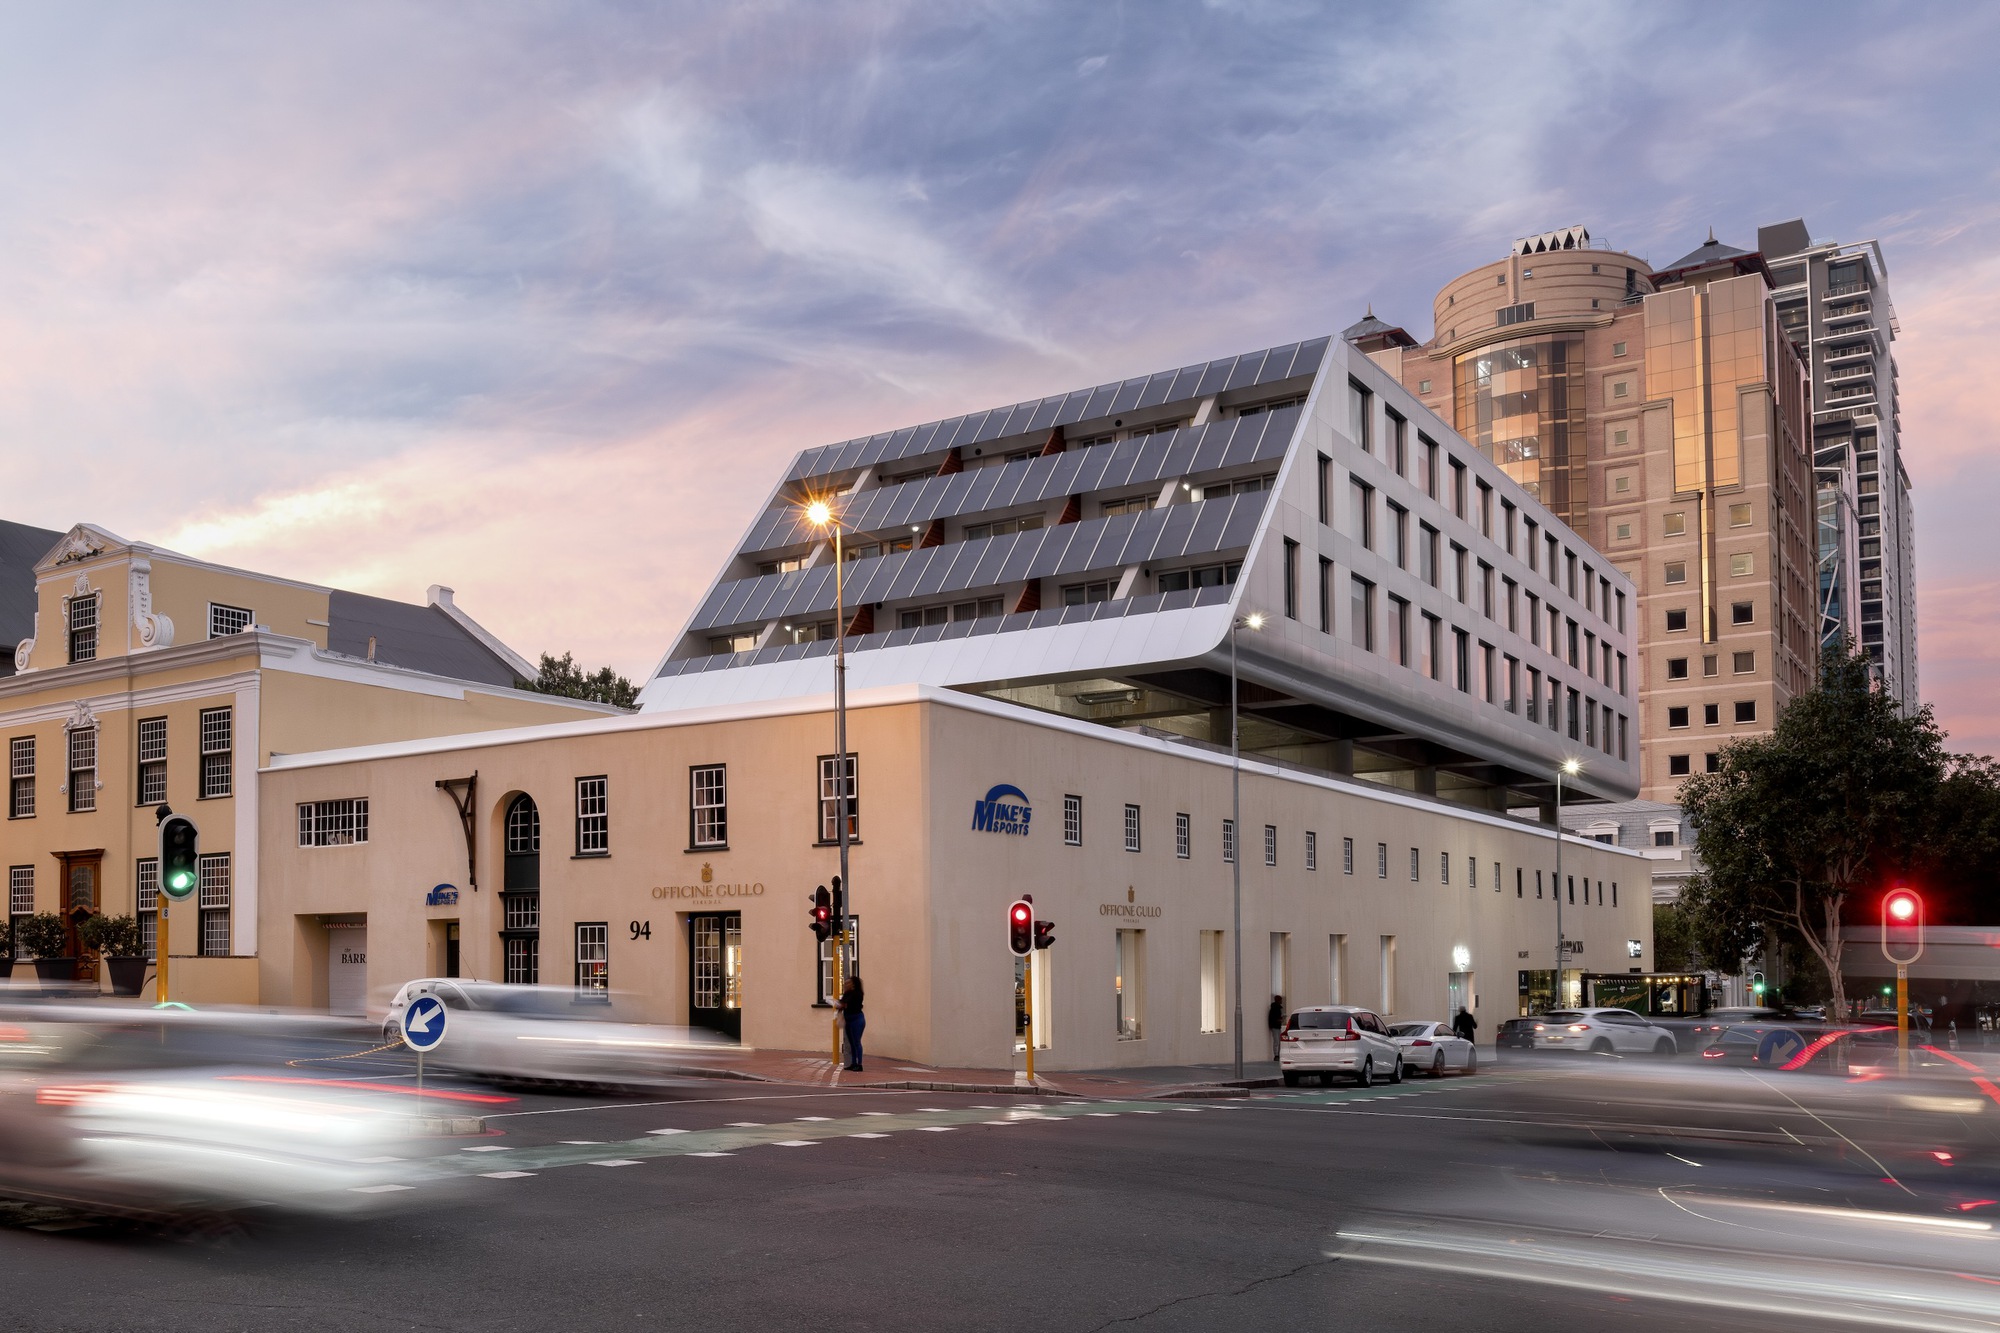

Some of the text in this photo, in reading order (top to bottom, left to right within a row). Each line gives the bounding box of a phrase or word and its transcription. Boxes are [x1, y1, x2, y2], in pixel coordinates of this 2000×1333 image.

[972, 800, 1032, 832] MIKE'S
[993, 821, 1029, 836] SPORTS
[652, 883, 764, 899] OFFICINE GULLO
[426, 892, 458, 905] MIKE'S
[164, 909, 168, 917] 8
[1100, 904, 1161, 917] OFFICINE GULLO
[630, 920, 651, 940] 94
[342, 953, 367, 964] BARR
